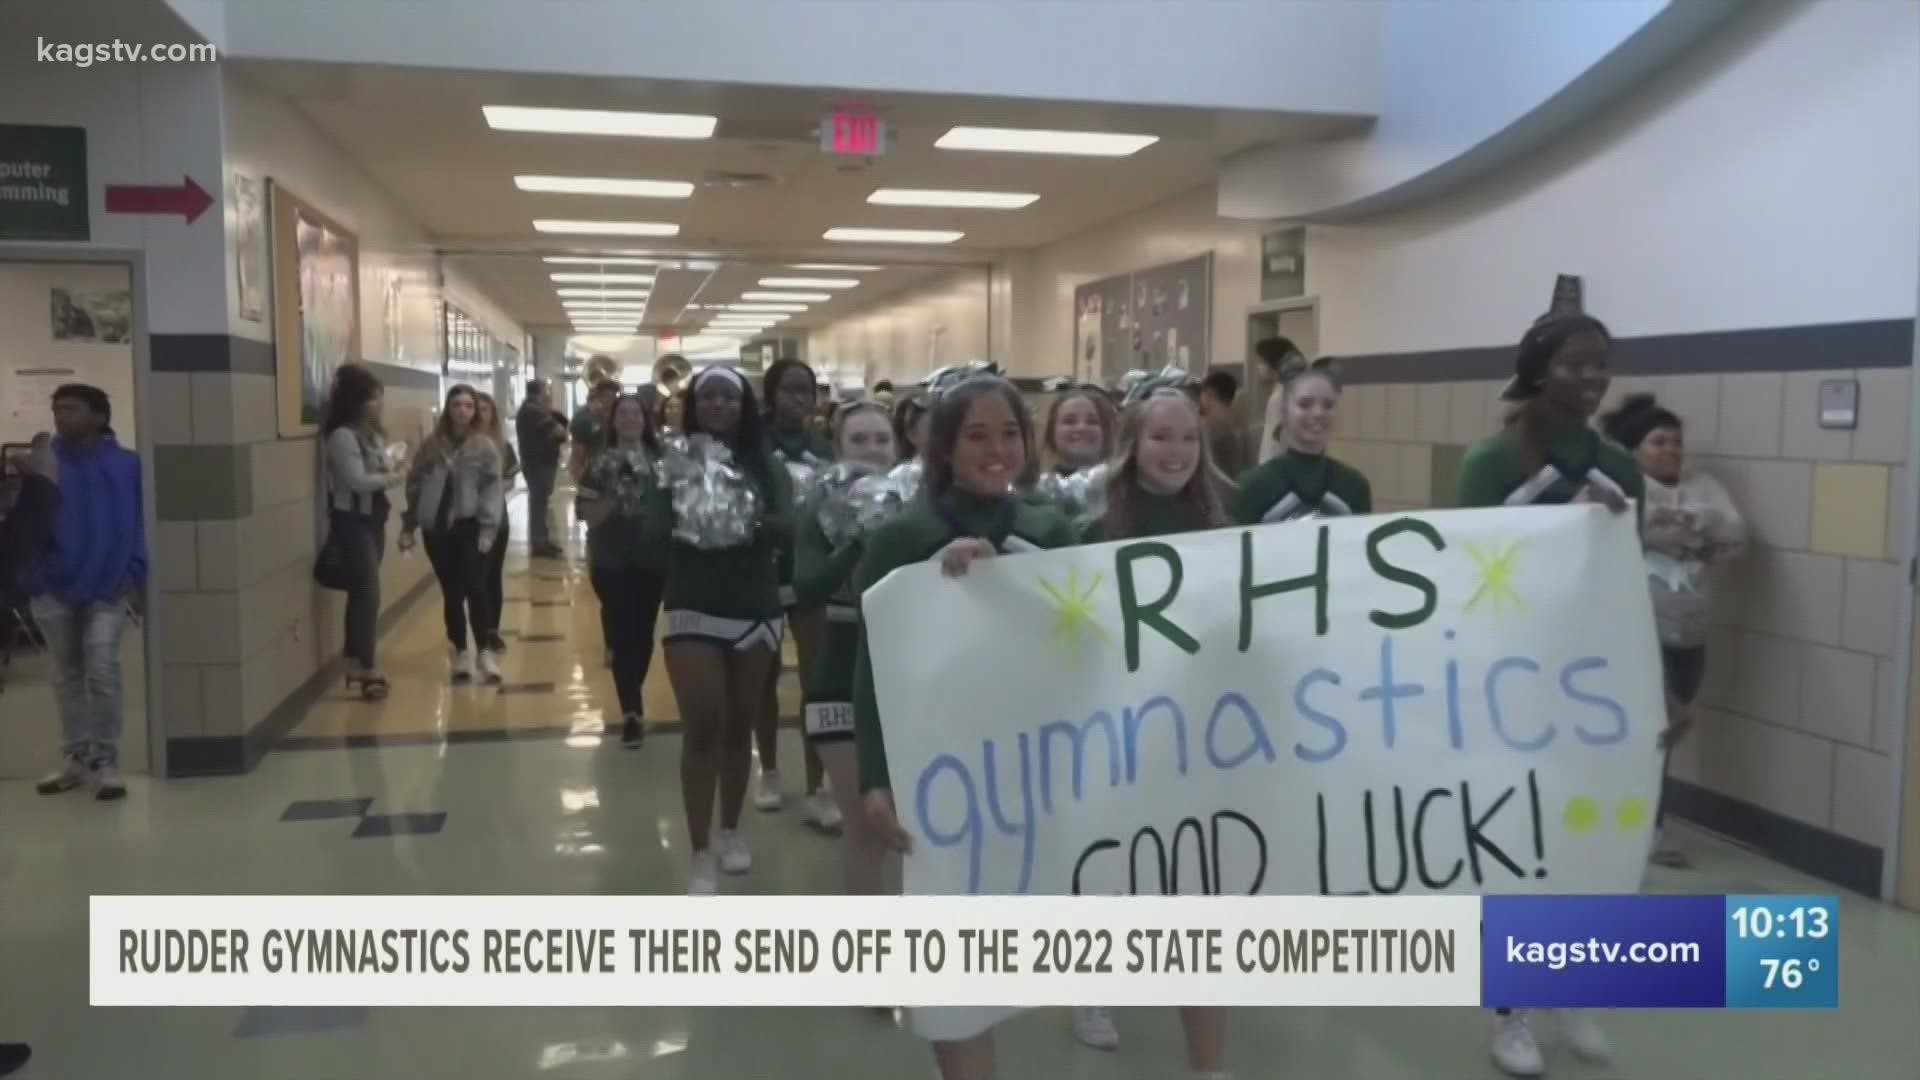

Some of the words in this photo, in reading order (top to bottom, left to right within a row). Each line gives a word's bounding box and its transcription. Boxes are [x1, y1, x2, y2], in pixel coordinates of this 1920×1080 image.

[1114, 517, 1447, 673] RHS
[914, 630, 1629, 896] gymnastics
[1317, 769, 1549, 896] LUCK!
